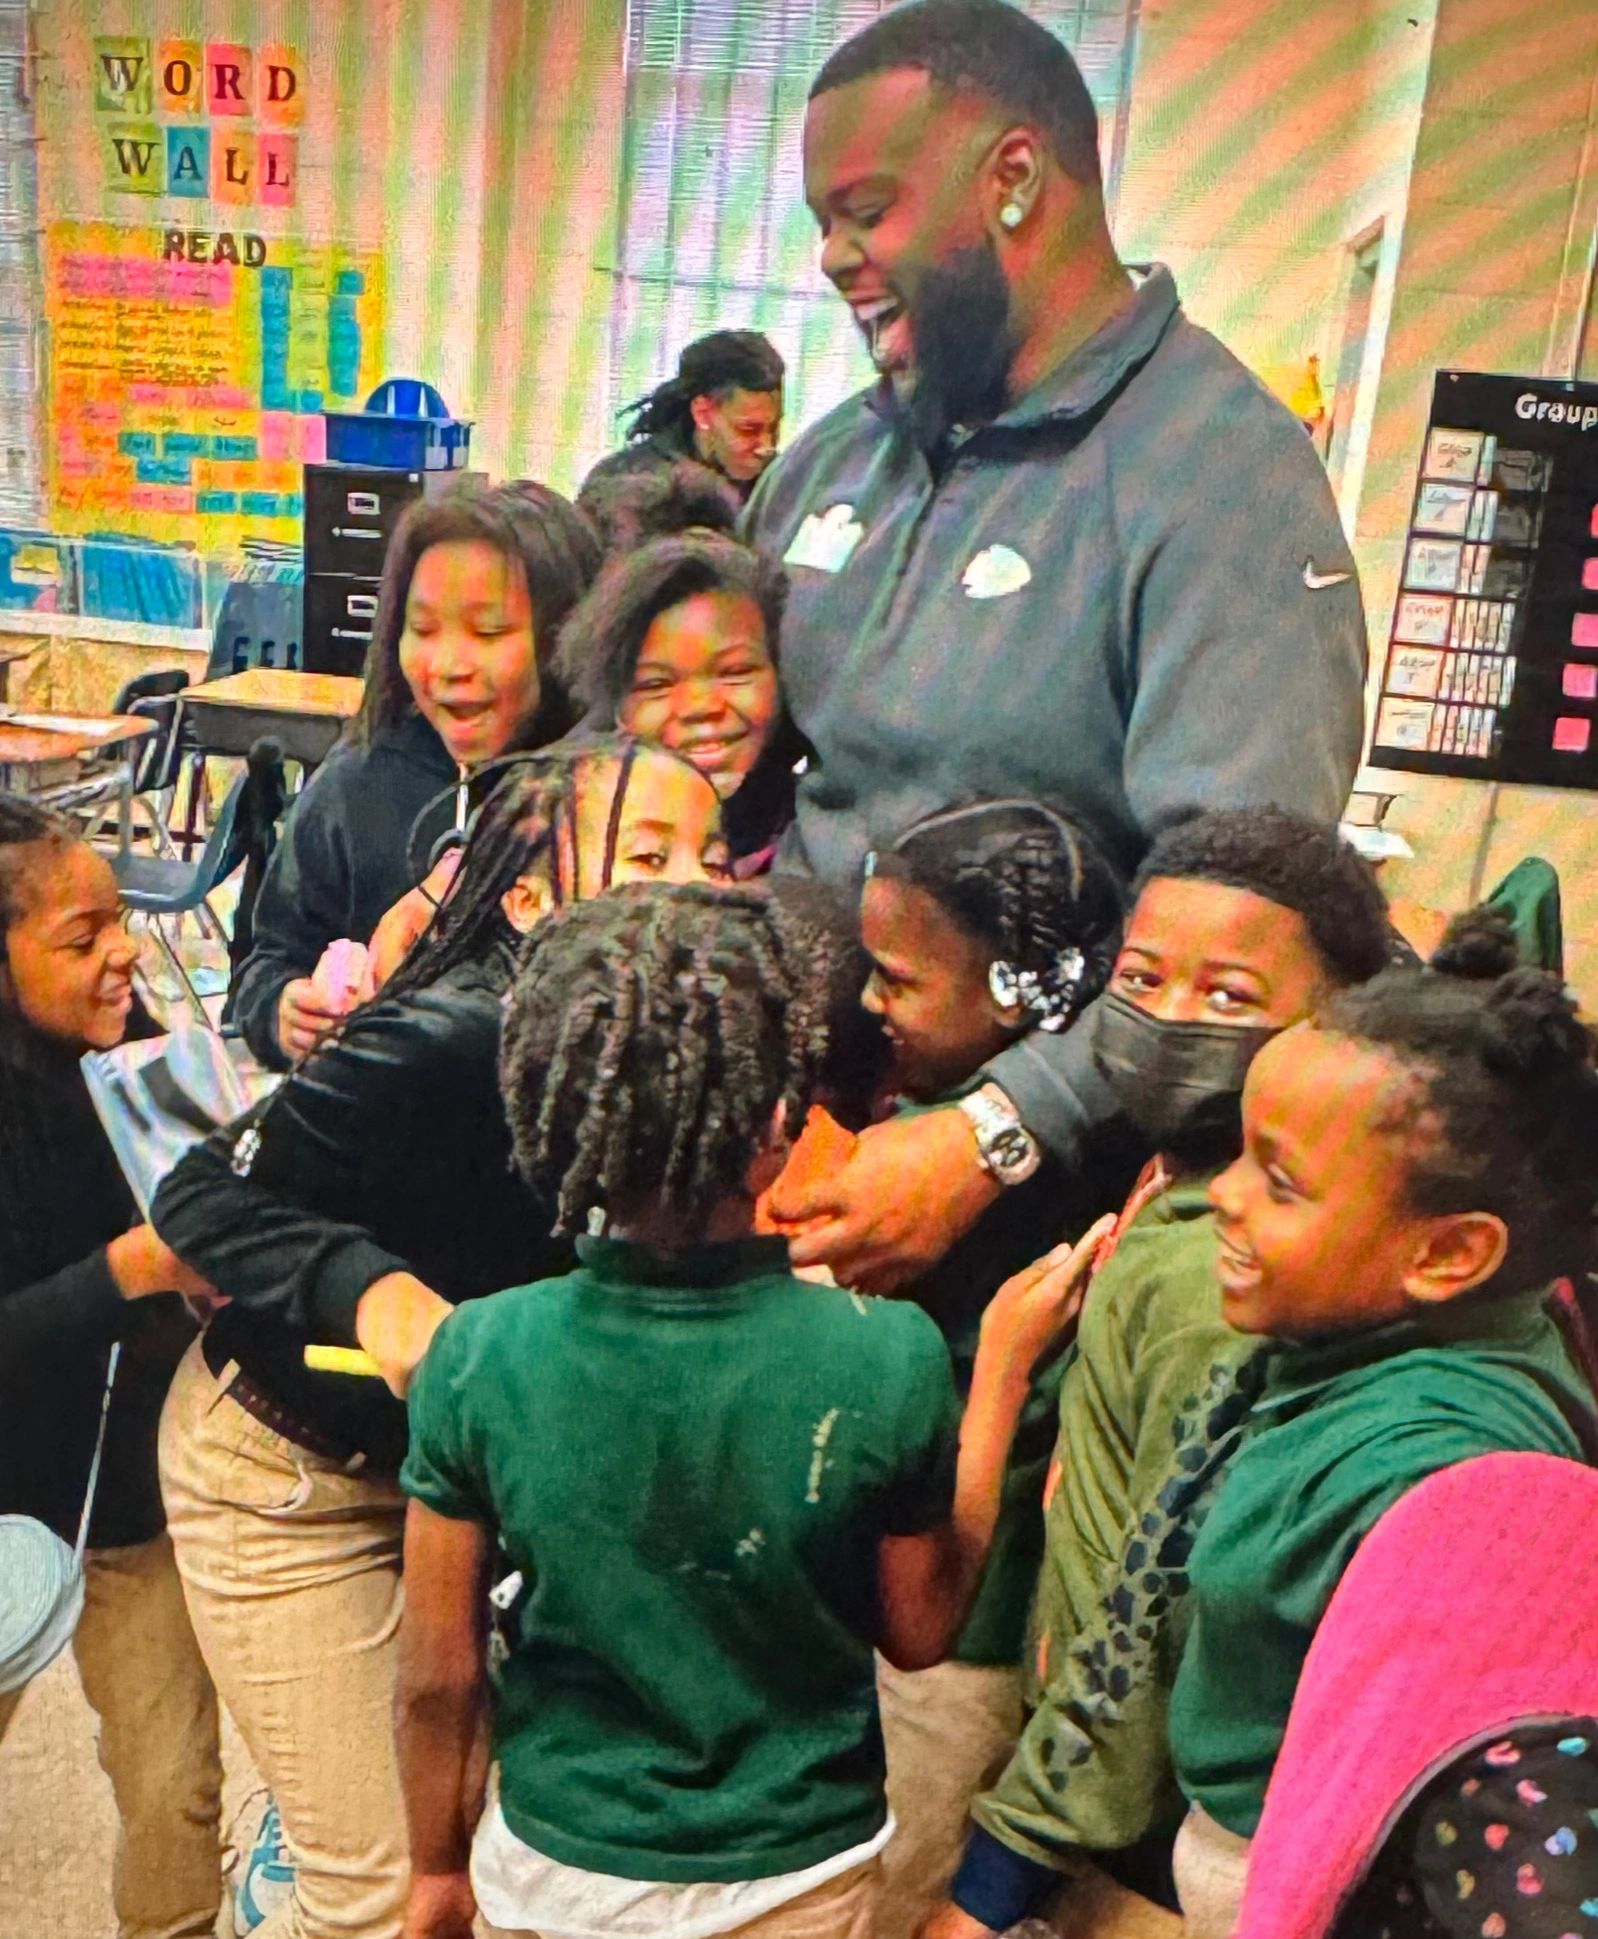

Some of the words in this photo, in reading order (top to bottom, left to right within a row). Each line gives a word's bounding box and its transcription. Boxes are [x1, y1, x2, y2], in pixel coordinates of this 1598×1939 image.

[101, 55, 297, 101] WORD
[112, 138, 290, 186] WALL
[163, 229, 267, 267] READ
[1514, 392, 1598, 432] Group
